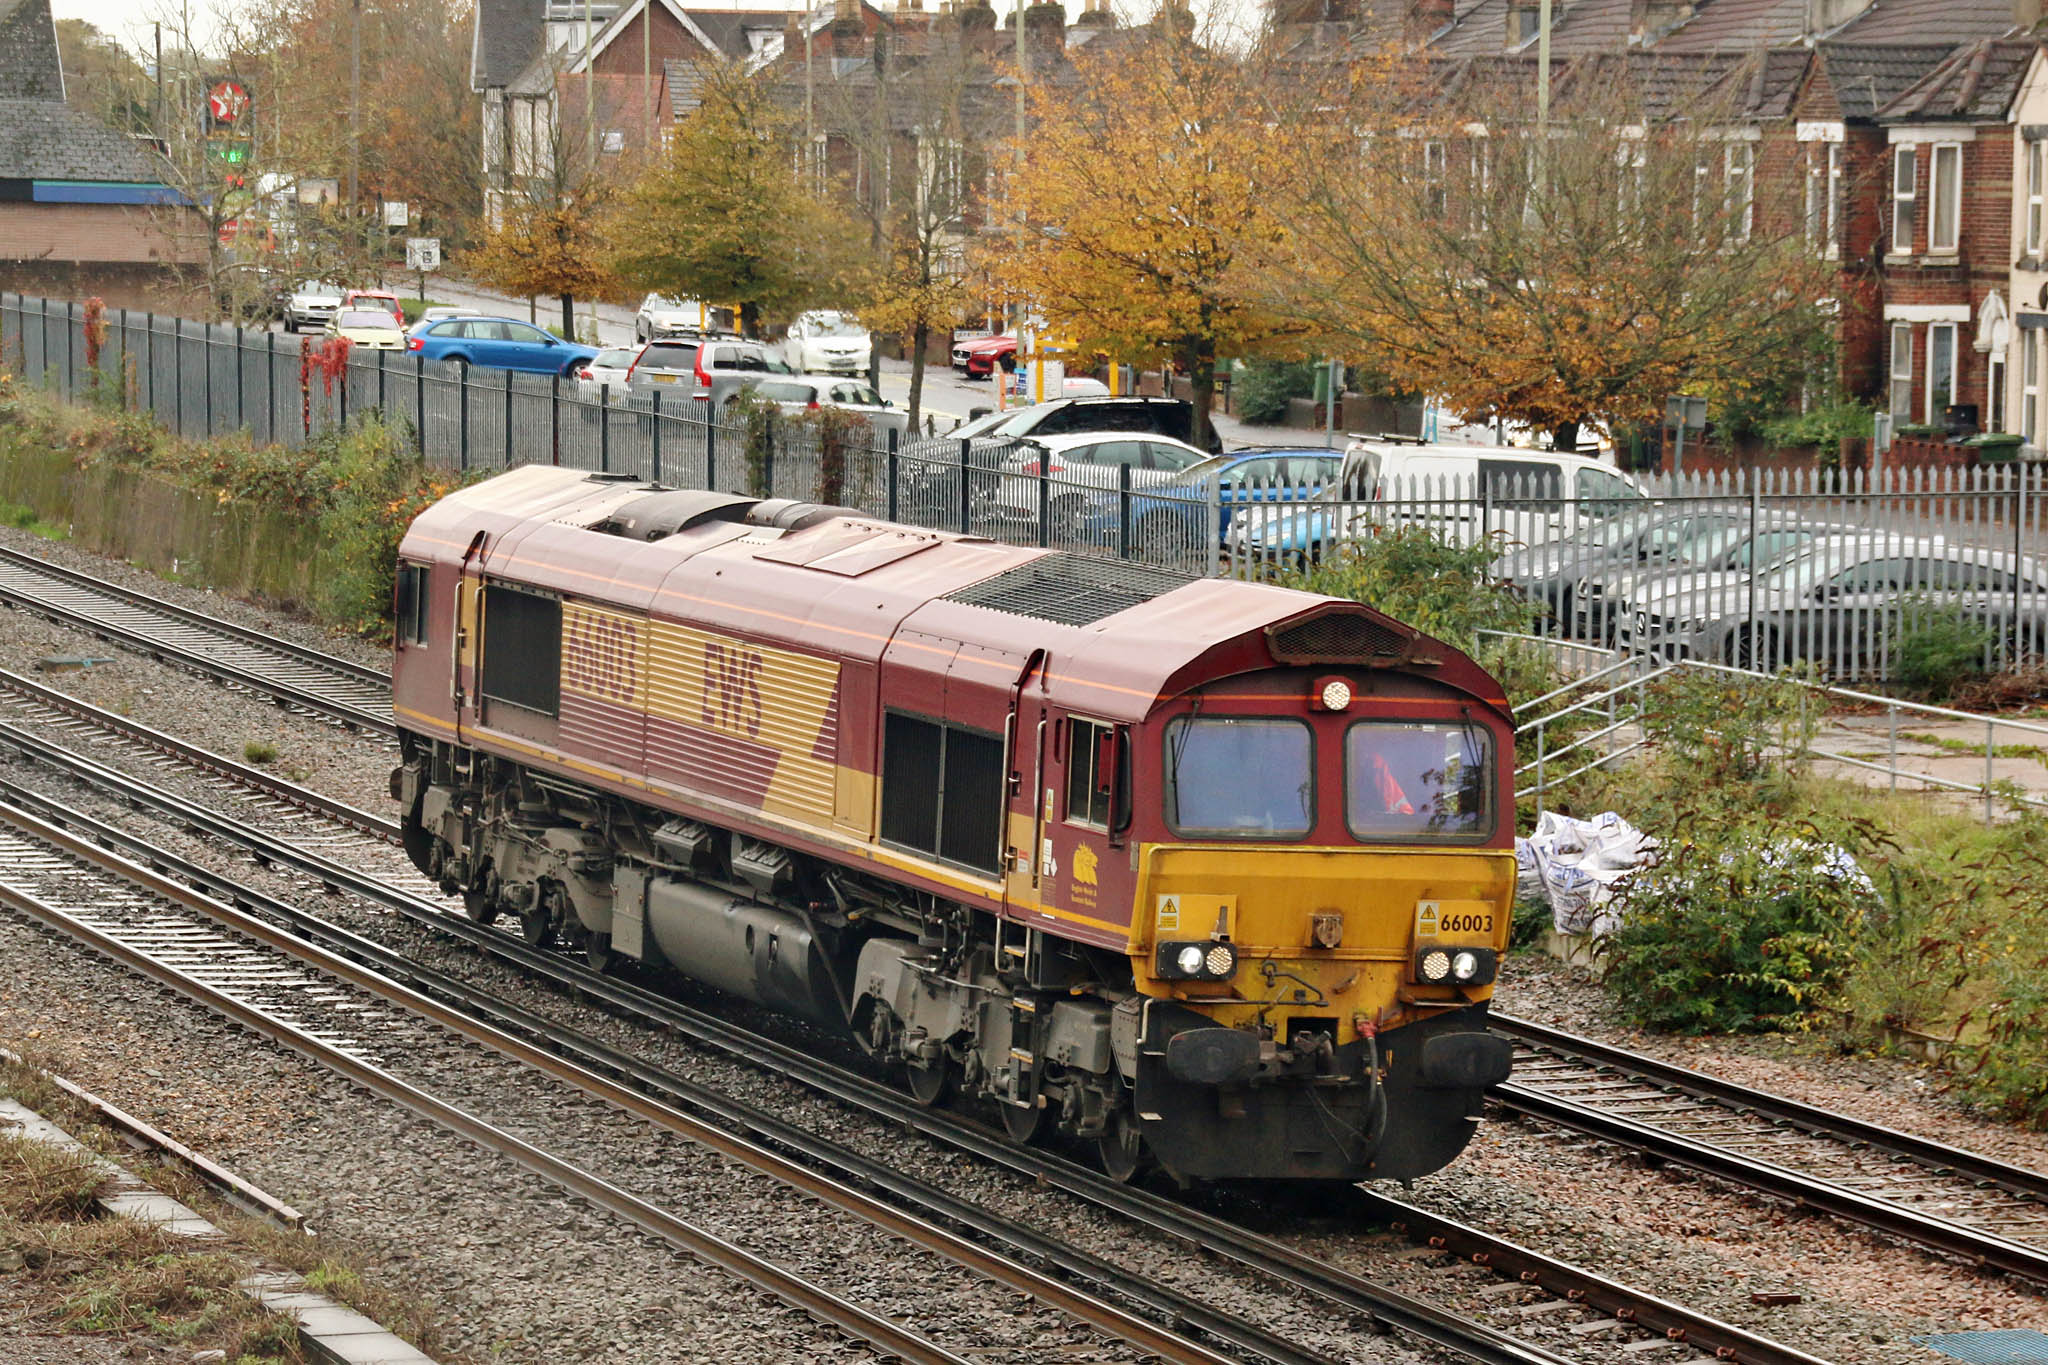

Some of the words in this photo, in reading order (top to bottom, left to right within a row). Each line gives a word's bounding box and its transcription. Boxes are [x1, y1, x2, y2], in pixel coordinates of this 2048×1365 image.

[567, 610, 636, 702] 66003
[702, 643, 763, 739] EWS
[1440, 914, 1494, 932] 66003
